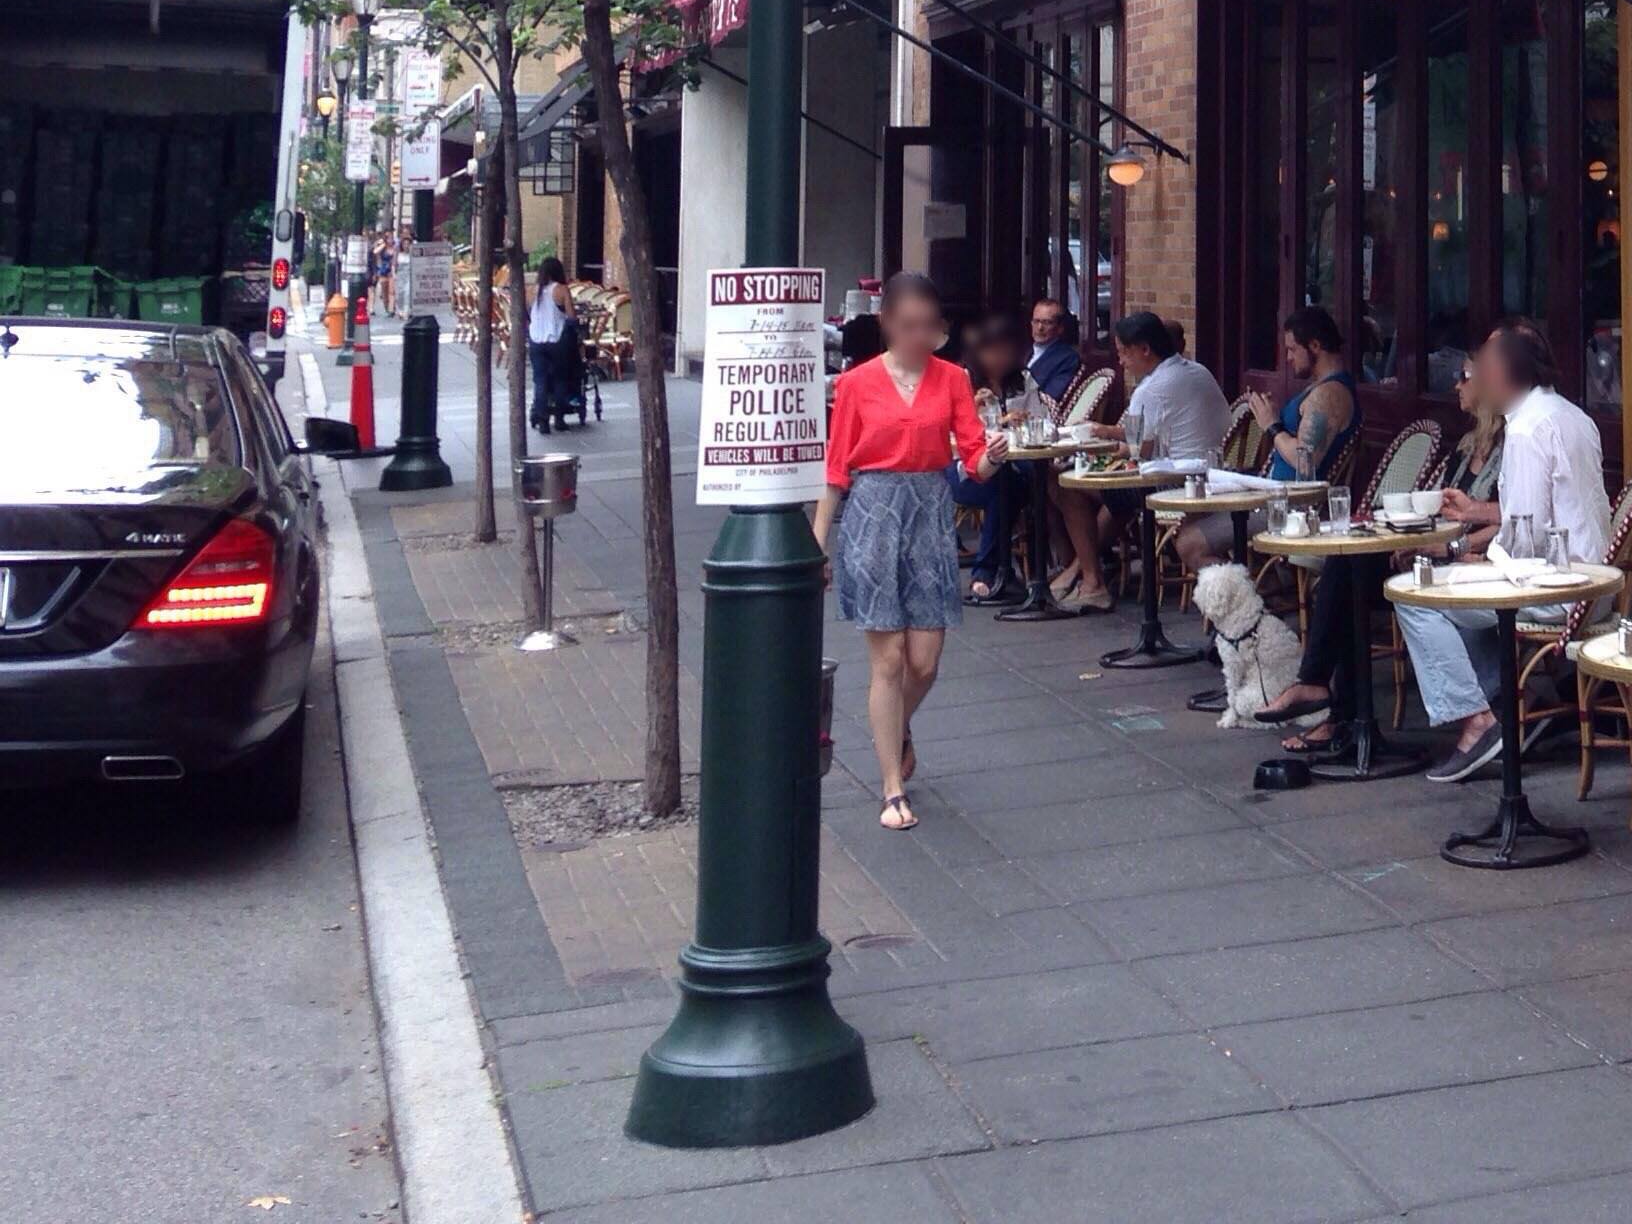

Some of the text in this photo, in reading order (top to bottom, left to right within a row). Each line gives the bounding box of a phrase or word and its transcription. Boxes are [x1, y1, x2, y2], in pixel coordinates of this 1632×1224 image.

[715, 275, 820, 302] NO STOPPING
[756, 307, 784, 315] FROM
[717, 363, 815, 385] TEMPORARY
[729, 389, 805, 416] POLICE
[714, 419, 817, 443] REGULATION
[708, 446, 822, 464] VEHICLES WILL BE TOWED
[735, 469, 747, 477] CITY
